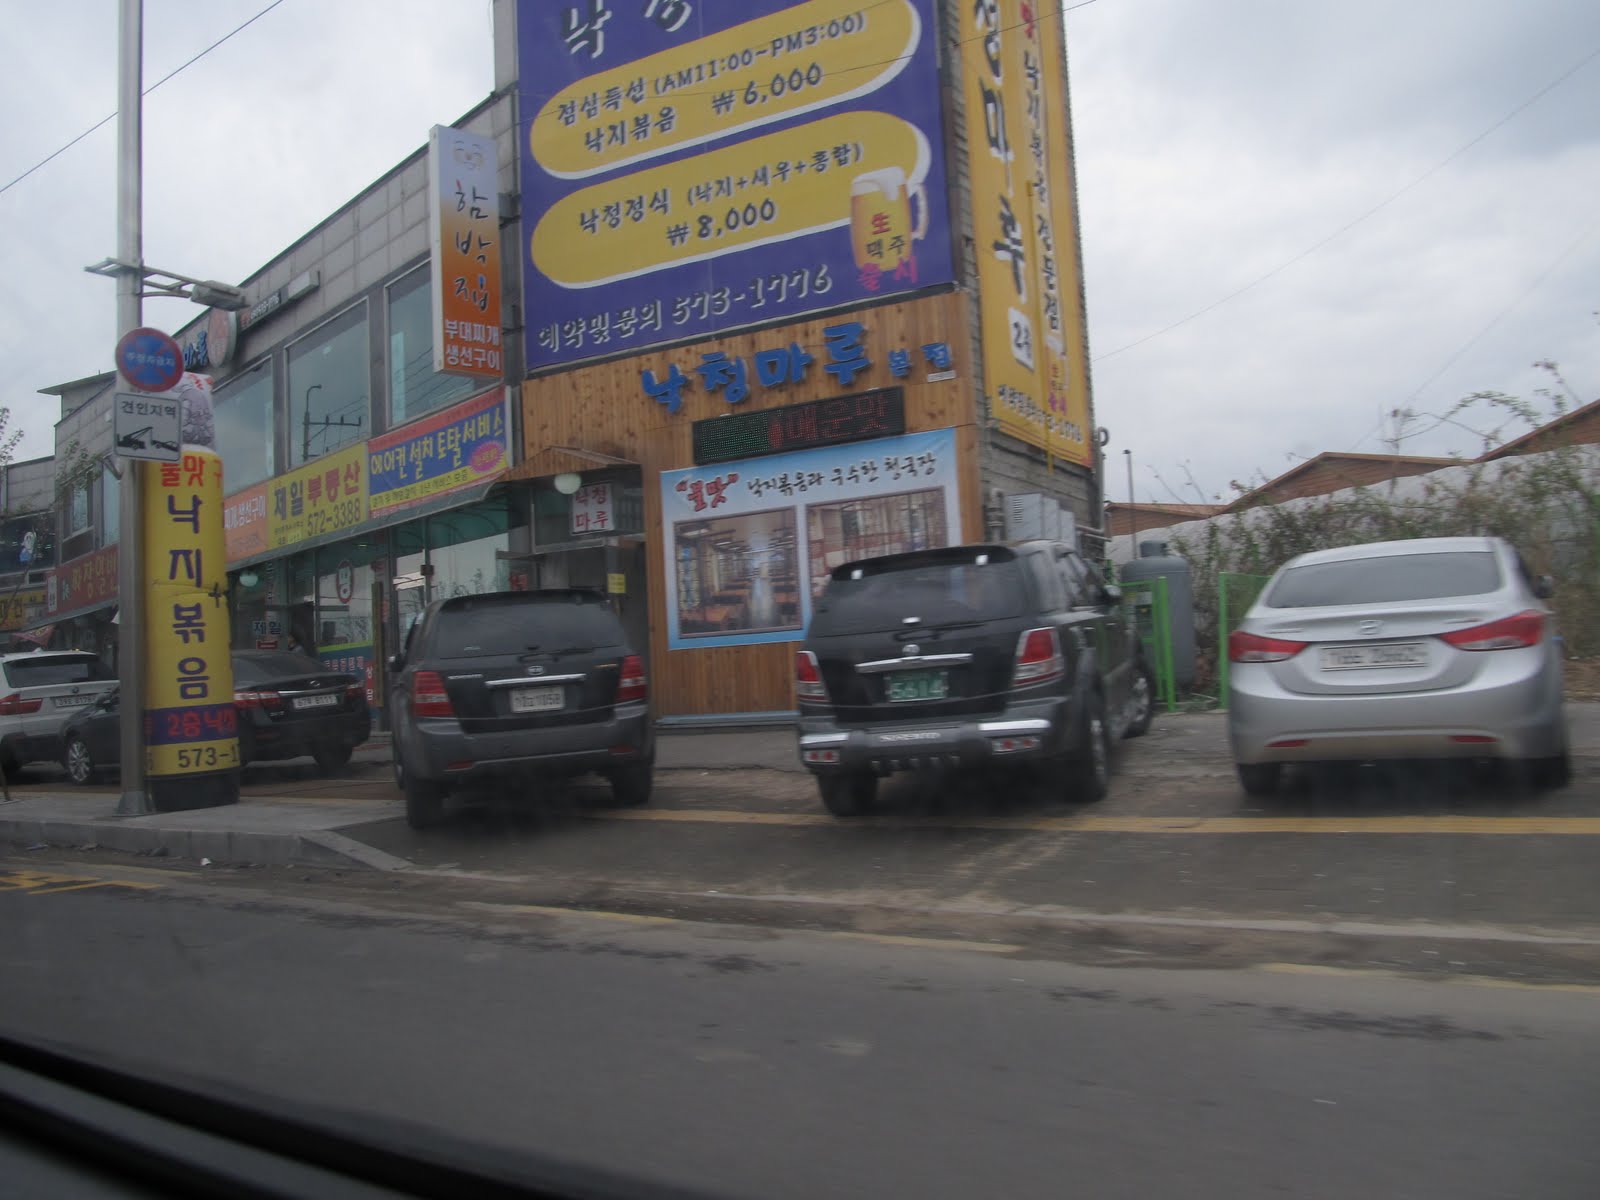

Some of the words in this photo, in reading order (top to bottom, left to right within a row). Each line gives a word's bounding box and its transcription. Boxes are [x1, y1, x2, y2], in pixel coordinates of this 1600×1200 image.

[584, 106, 677, 152] 낙지볶음
[579, 188, 670, 234] 낙청정식
[671, 264, 833, 324] 573-1776
[444, 318, 500, 347] 부대찌개
[445, 347, 500, 371] 생선구이
[640, 321, 873, 414] 낙청마루
[888, 341, 953, 377] 본점
[121, 400, 176, 420] 견인지역
[370, 445, 408, 480] 에어컨
[410, 436, 434, 480] 설치
[829, 460, 879, 485] 구수한
[884, 450, 937, 483] 청국장
[307, 498, 361, 537] 572-3388
[166, 494, 210, 700] 낙지볶음
